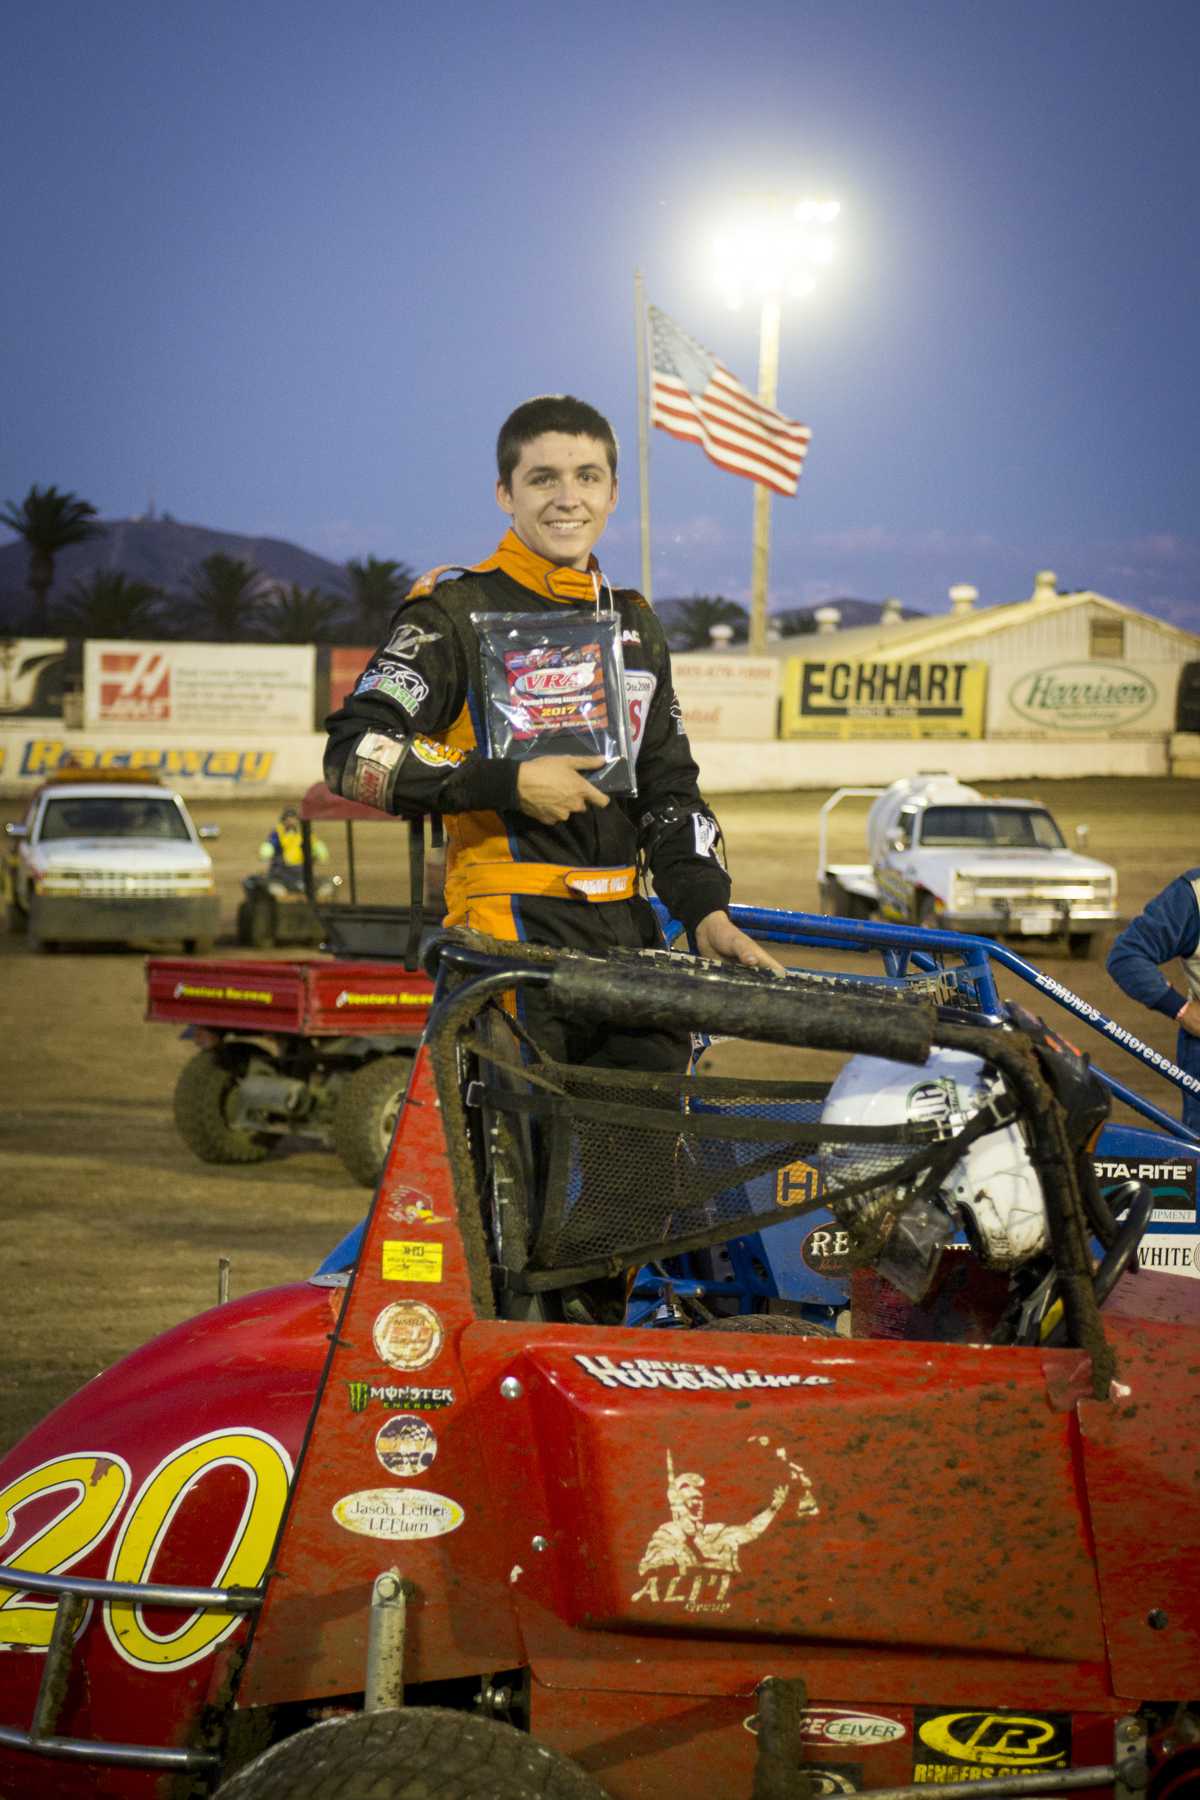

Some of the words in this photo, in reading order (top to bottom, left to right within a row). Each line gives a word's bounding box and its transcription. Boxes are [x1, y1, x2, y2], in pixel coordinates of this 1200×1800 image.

[525, 671, 582, 691] VRA
[800, 663, 968, 716] ECKHART
[1024, 673, 1149, 710] Harrison
[541, 703, 578, 717] 2017
[20, 740, 275, 784] Raceway
[1036, 975, 1103, 1021] EDMUNDS
[1139, 1247, 1192, 1267] WHITE
[371, 1385, 454, 1401] MONSTER
[351, 1501, 394, 1515] Jason
[0, 1426, 296, 1673] 20
